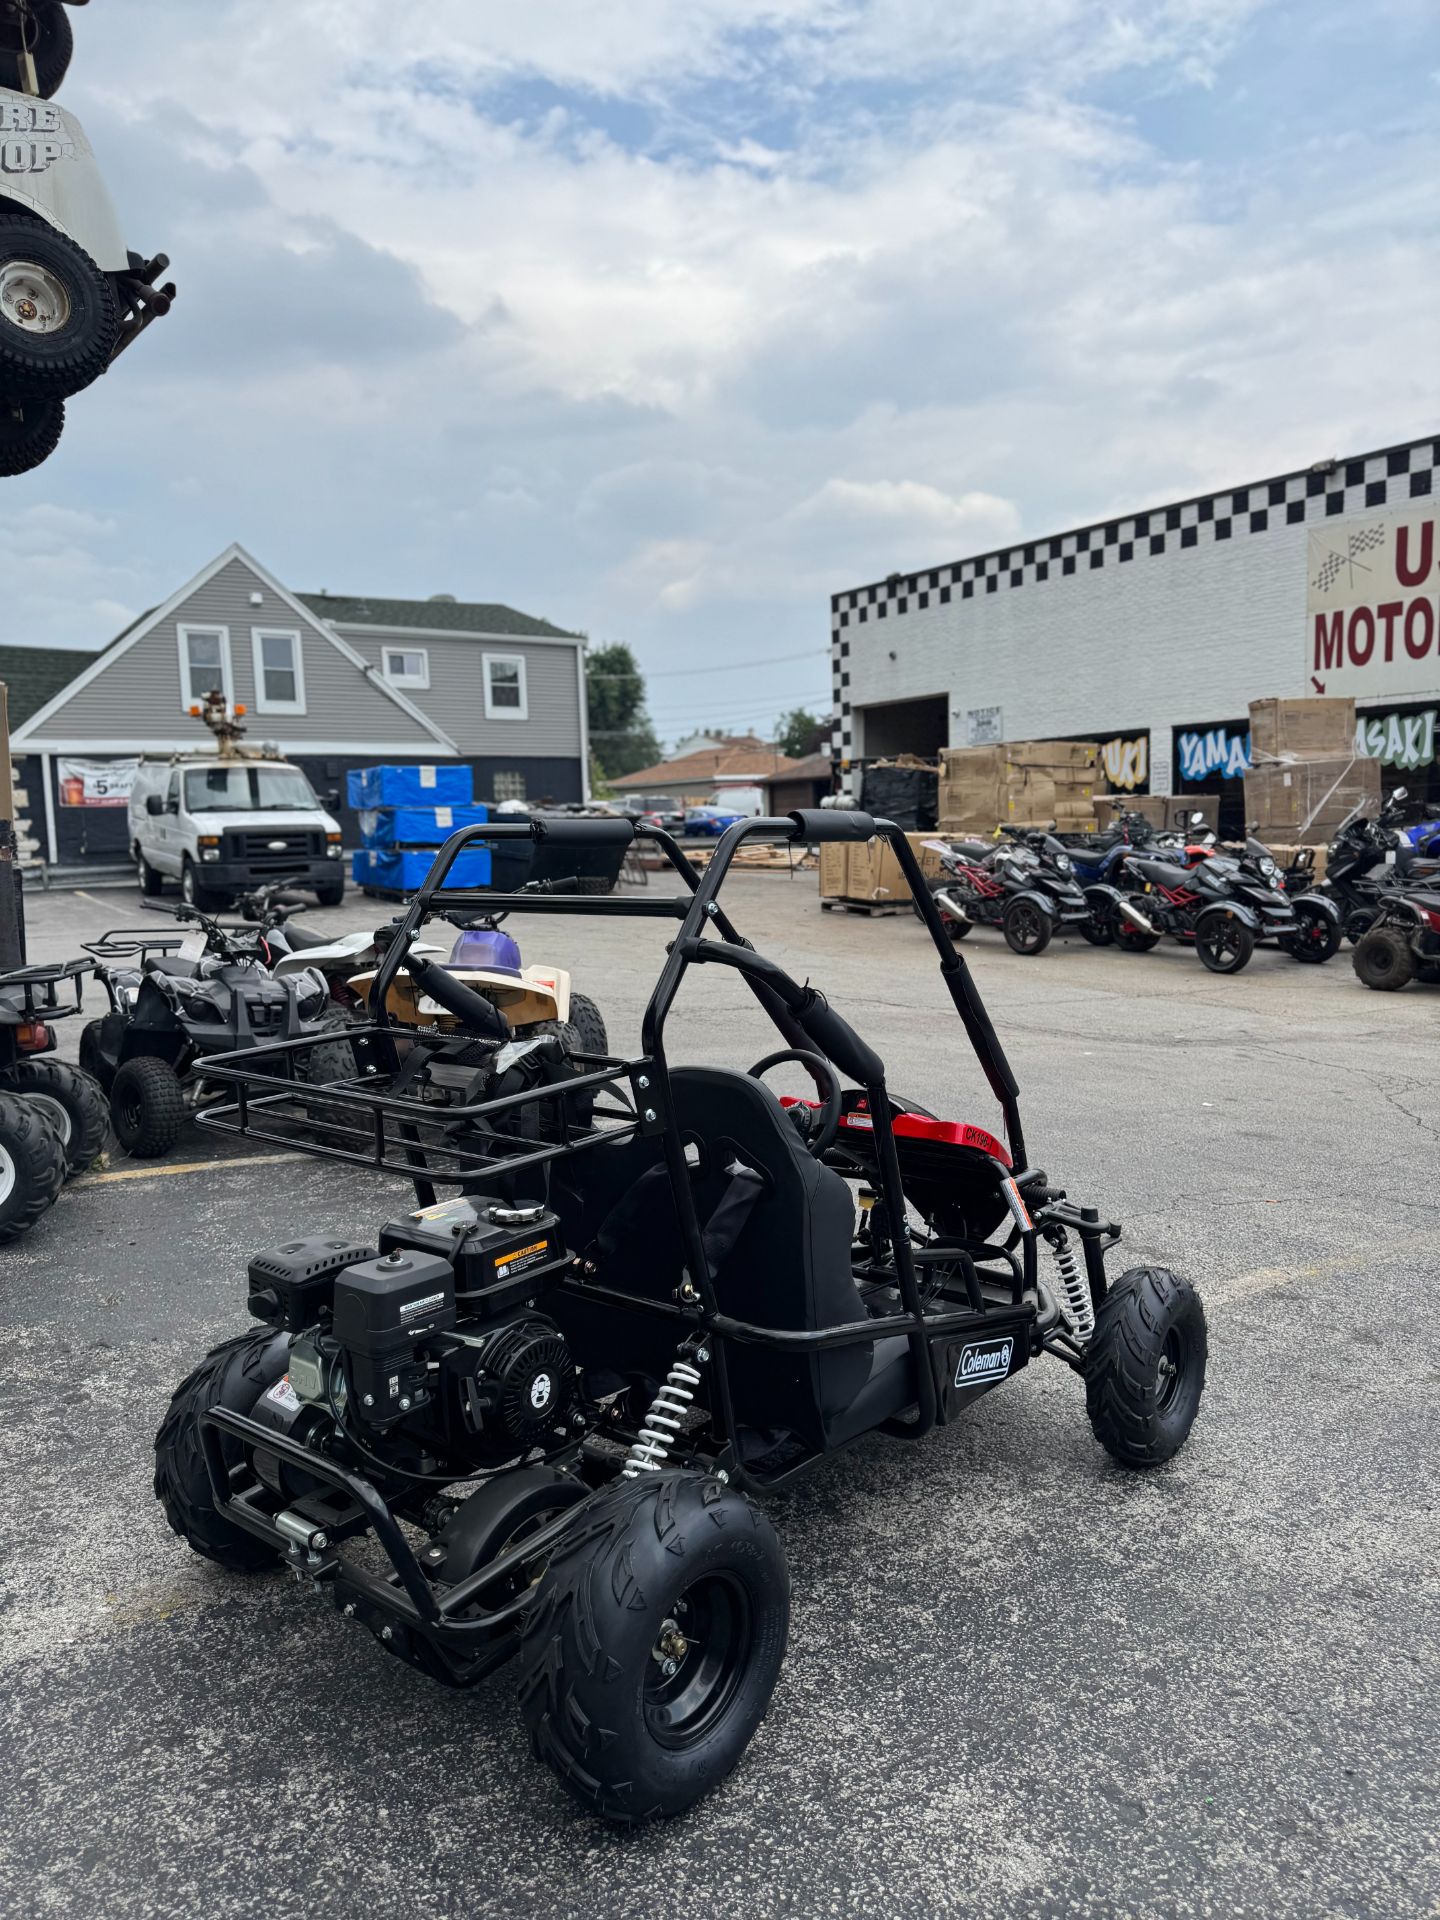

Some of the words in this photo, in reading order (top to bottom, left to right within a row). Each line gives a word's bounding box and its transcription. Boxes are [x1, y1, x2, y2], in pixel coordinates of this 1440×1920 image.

[1396, 521, 1440, 587] U
[1314, 597, 1440, 671] MOTO
[1102, 737, 1148, 788] UKI
[1178, 729, 1252, 781] YAMA
[961, 1348, 1001, 1376] Coleman
